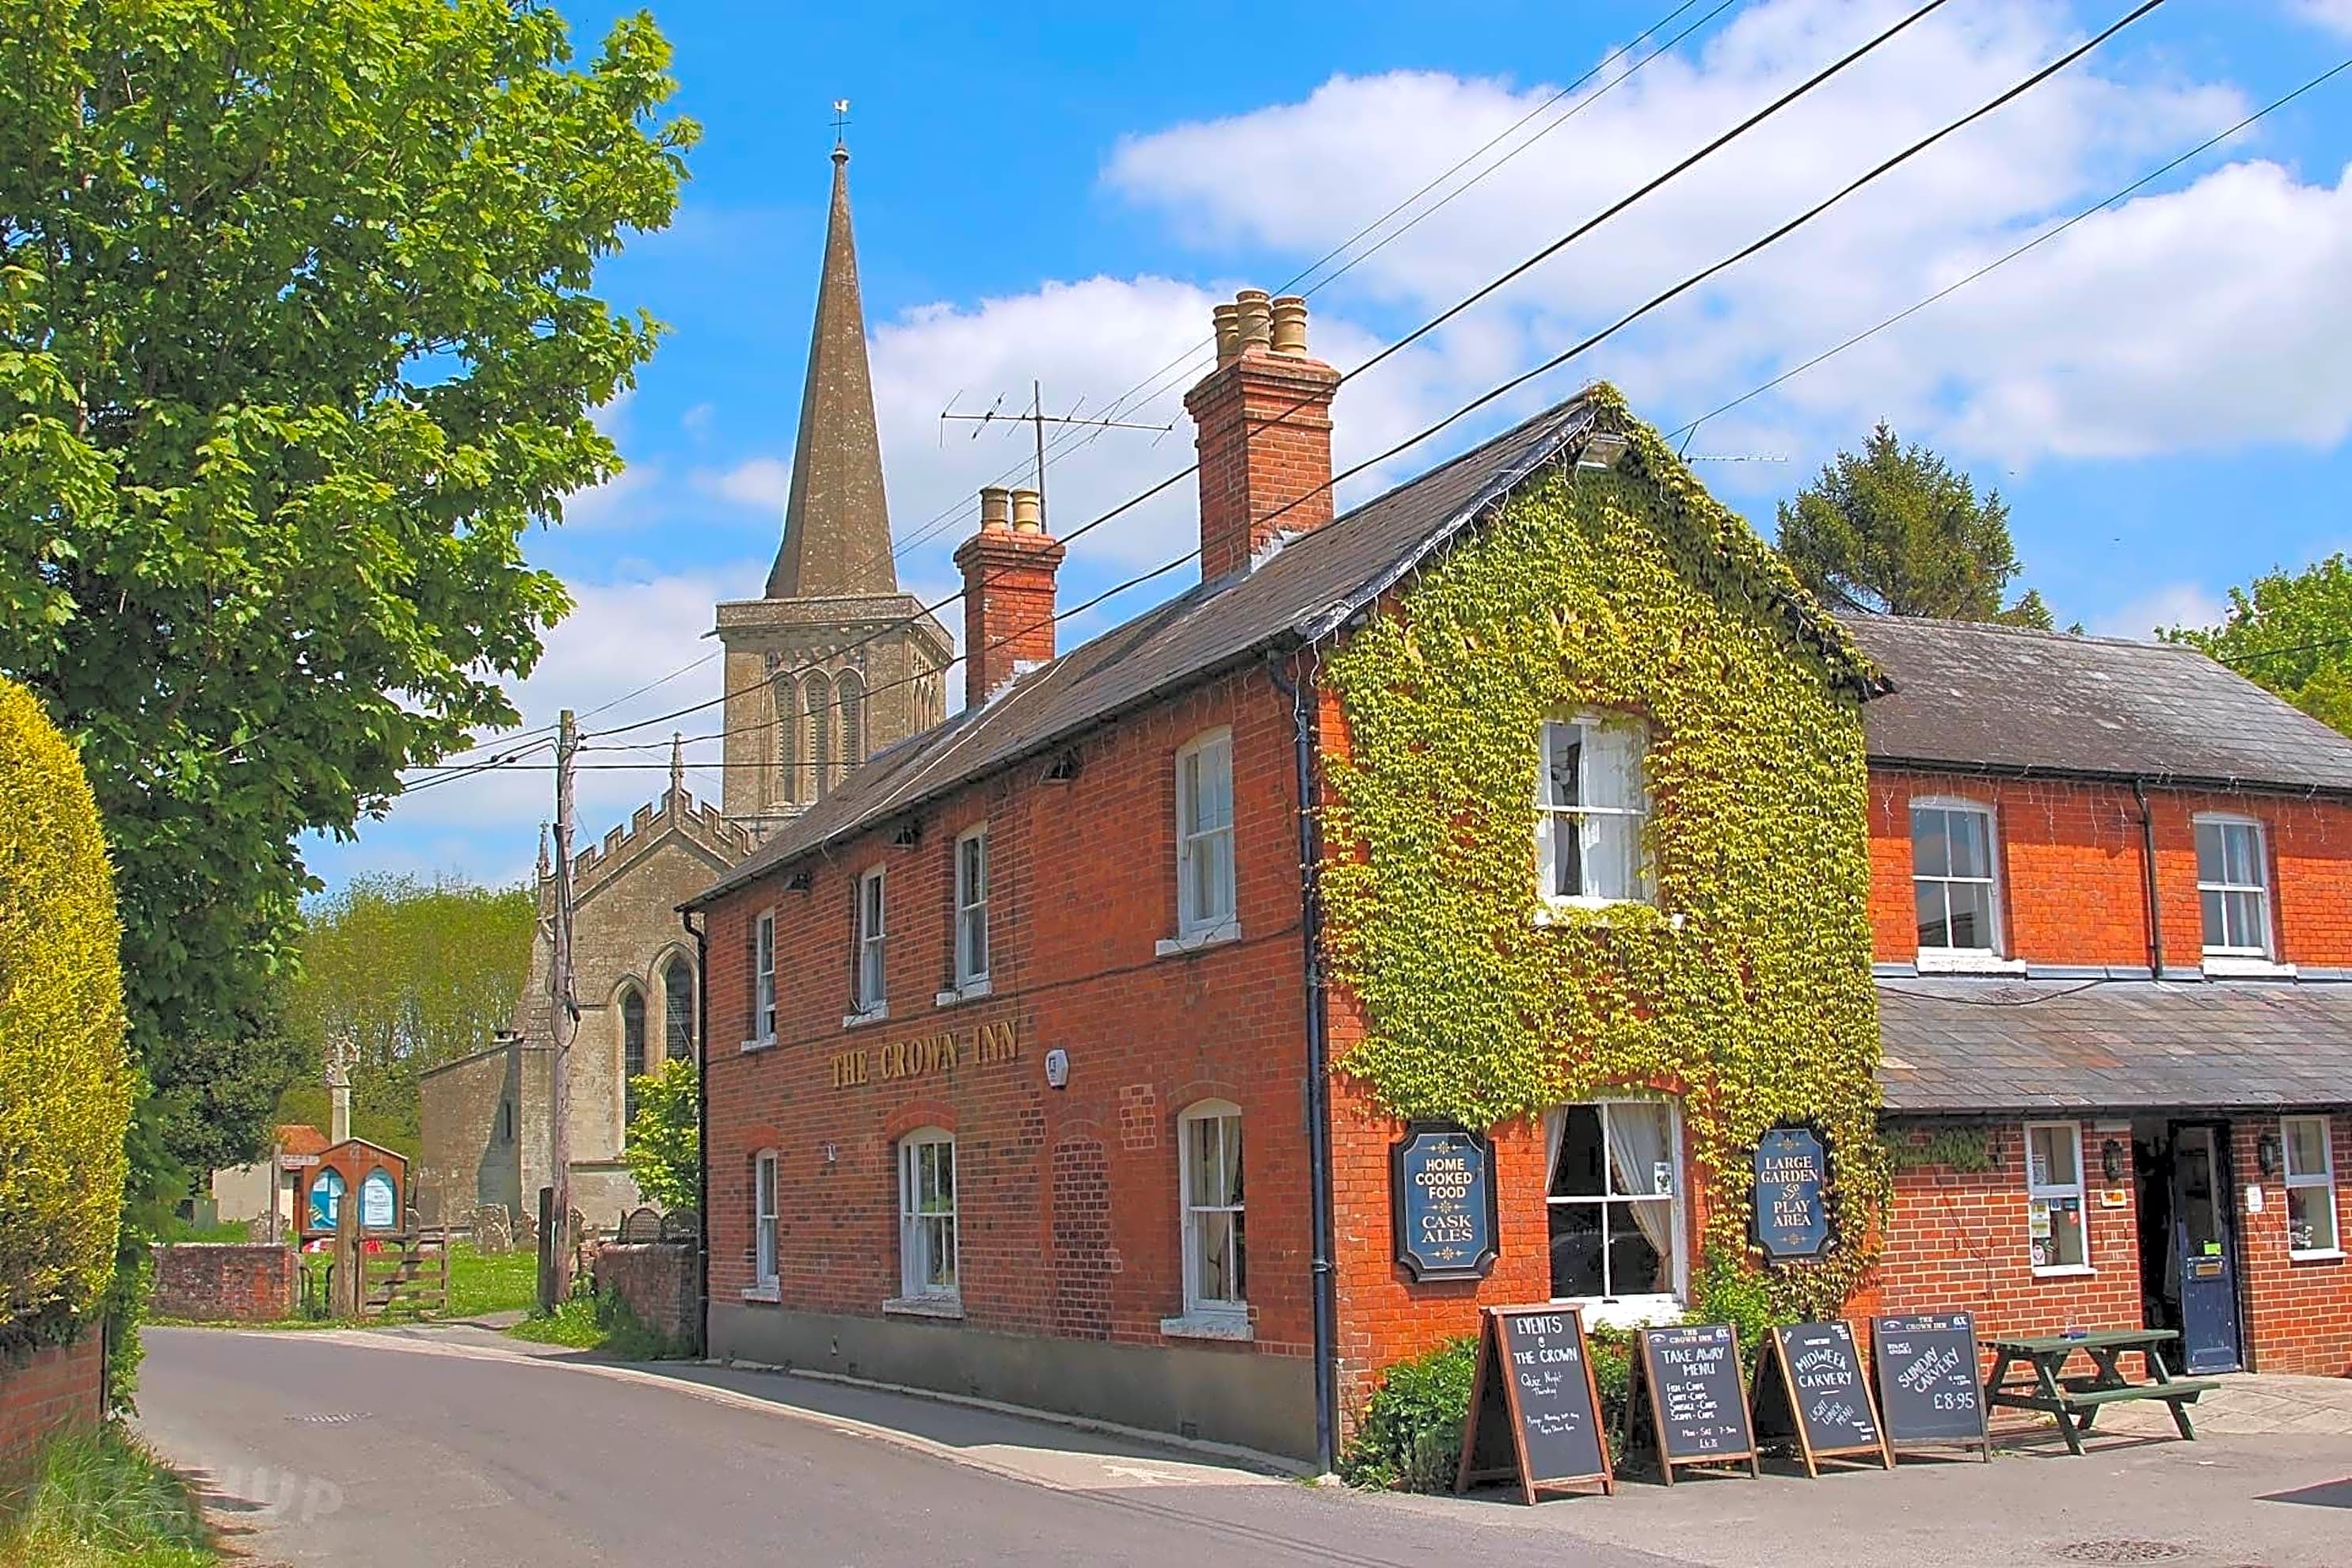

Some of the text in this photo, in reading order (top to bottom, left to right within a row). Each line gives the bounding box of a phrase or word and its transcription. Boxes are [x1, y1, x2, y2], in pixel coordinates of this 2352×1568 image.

[831, 1019, 1018, 1088] THE CROWN INN
[1425, 1159, 1464, 1171] HOME
[1766, 1156, 1813, 1170] LARGE
[1415, 1172, 1472, 1186] COOKED
[1760, 1169, 1818, 1183] GARDEN
[1429, 1186, 1466, 1200] FOOD
[1774, 1200, 1810, 1213] PLAY
[1422, 1215, 1472, 1228] CASK
[1773, 1214, 1812, 1227] AREA
[1421, 1228, 1473, 1243] ALES
[1517, 1316, 1563, 1334] EVENTS
[1513, 1347, 1578, 1364] THE CROWN
[1661, 1347, 1725, 1364] TAKE AWAY
[1795, 1349, 1847, 1373] MIDWEEK
[1682, 1362, 1716, 1376] MENU
[1898, 1346, 1939, 1388] SUNDAY
[1914, 1347, 1960, 1393] CARVERY
[1798, 1371, 1852, 1387] CARVERY
